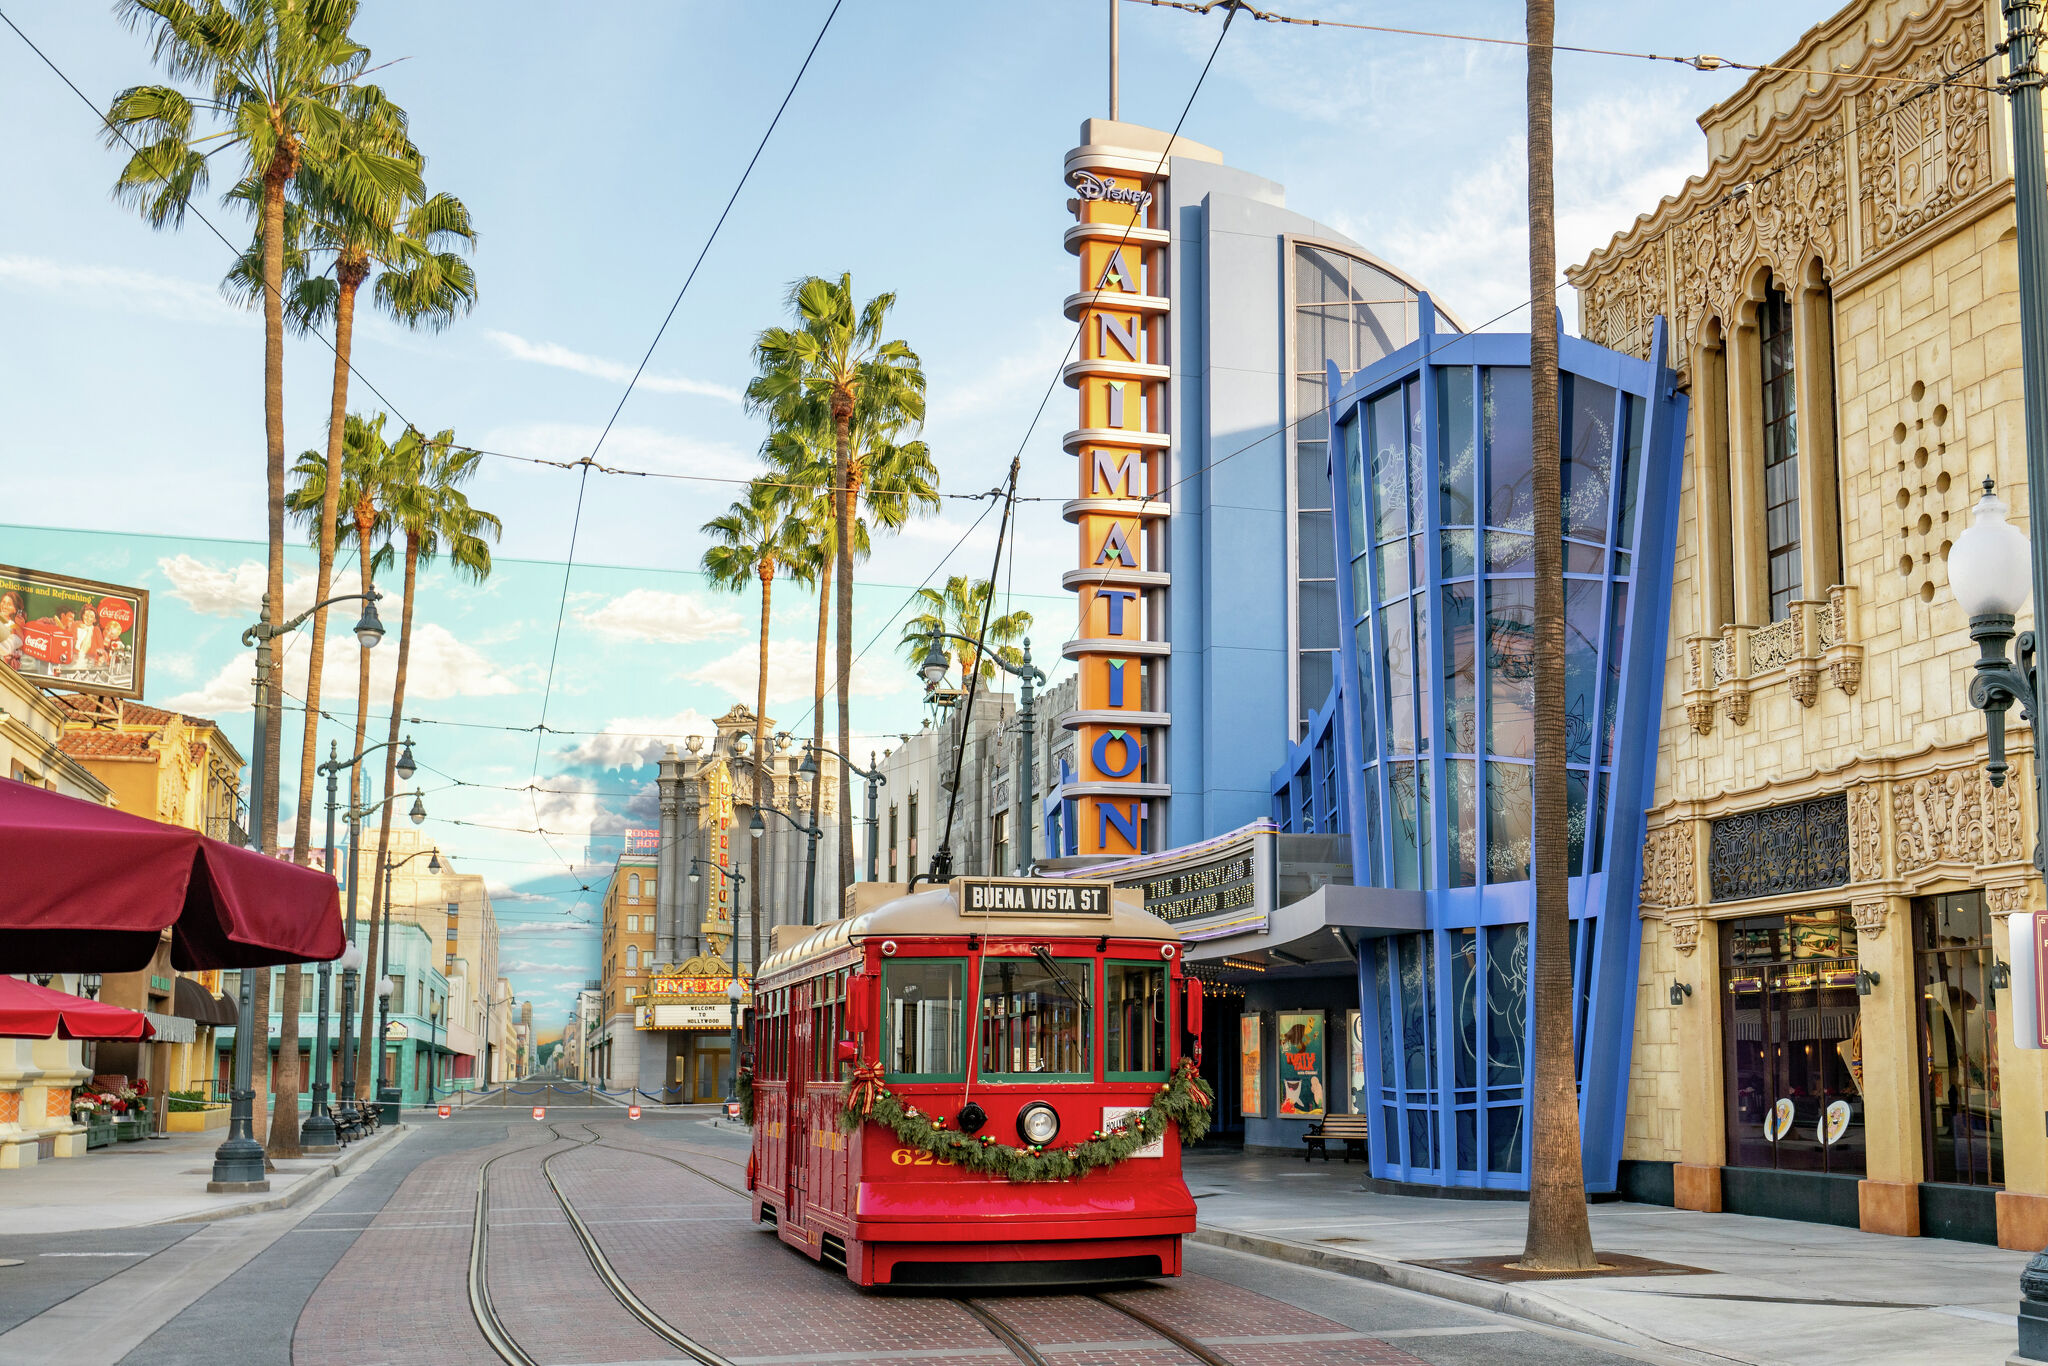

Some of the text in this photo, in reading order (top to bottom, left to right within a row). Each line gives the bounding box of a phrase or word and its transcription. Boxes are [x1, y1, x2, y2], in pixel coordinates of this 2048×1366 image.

[1073, 170, 1152, 215] Disney
[1091, 247, 1141, 850] ANIMATION
[0, 580, 34, 593] Delicious
[35, 587, 50, 597] and
[718, 782, 729, 921] HYPERION
[973, 886, 1101, 911] BUENA VISTA ST
[1150, 879, 1172, 899] THE
[1180, 860, 1244, 894] DISNEYLAND
